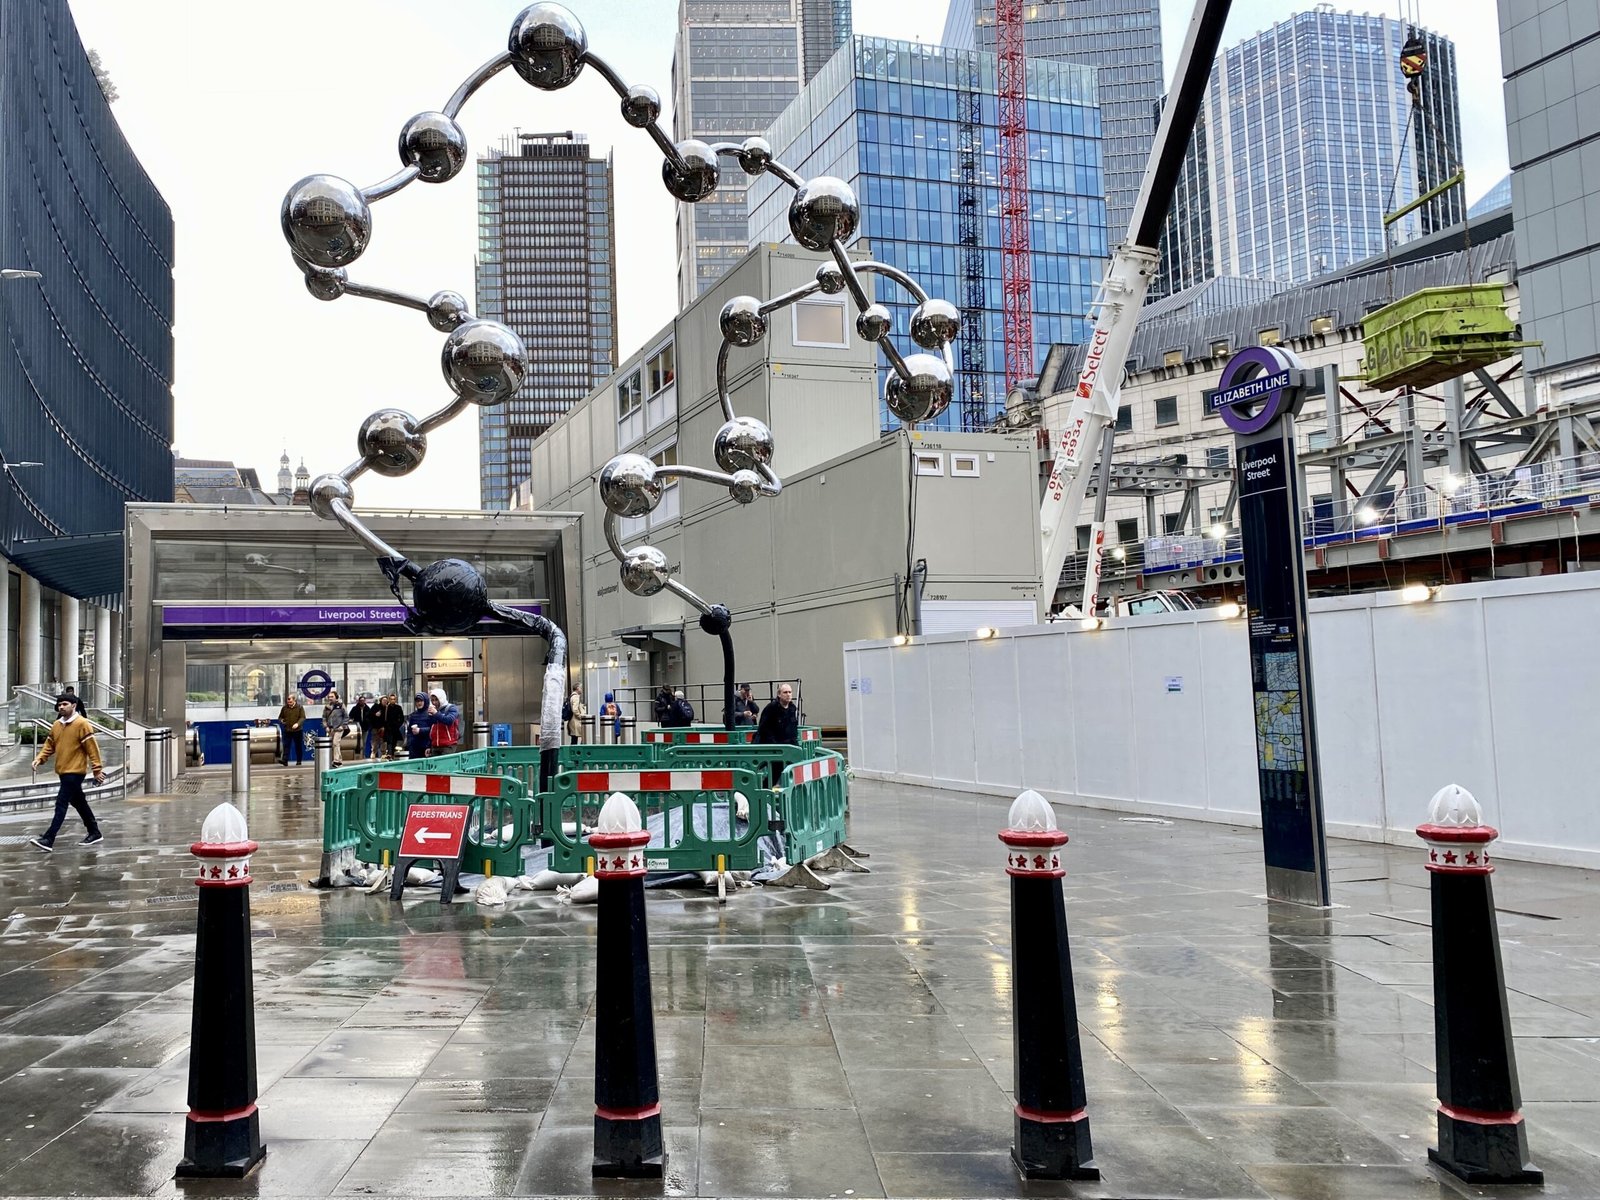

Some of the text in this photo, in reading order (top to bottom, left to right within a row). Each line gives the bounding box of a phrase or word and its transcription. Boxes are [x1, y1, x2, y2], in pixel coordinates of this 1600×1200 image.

[1081, 329, 1109, 383] Select
[1367, 330, 1428, 371] Gecko
[1214, 374, 1288, 406] ELIZABETH LINE
[1066, 418, 1084, 458] 5934
[1241, 454, 1277, 471] Liverpool
[1247, 467, 1271, 481] Street
[318, 610, 401, 621] Liverpool Street
[411, 810, 463, 819] PEDESTRIANS
